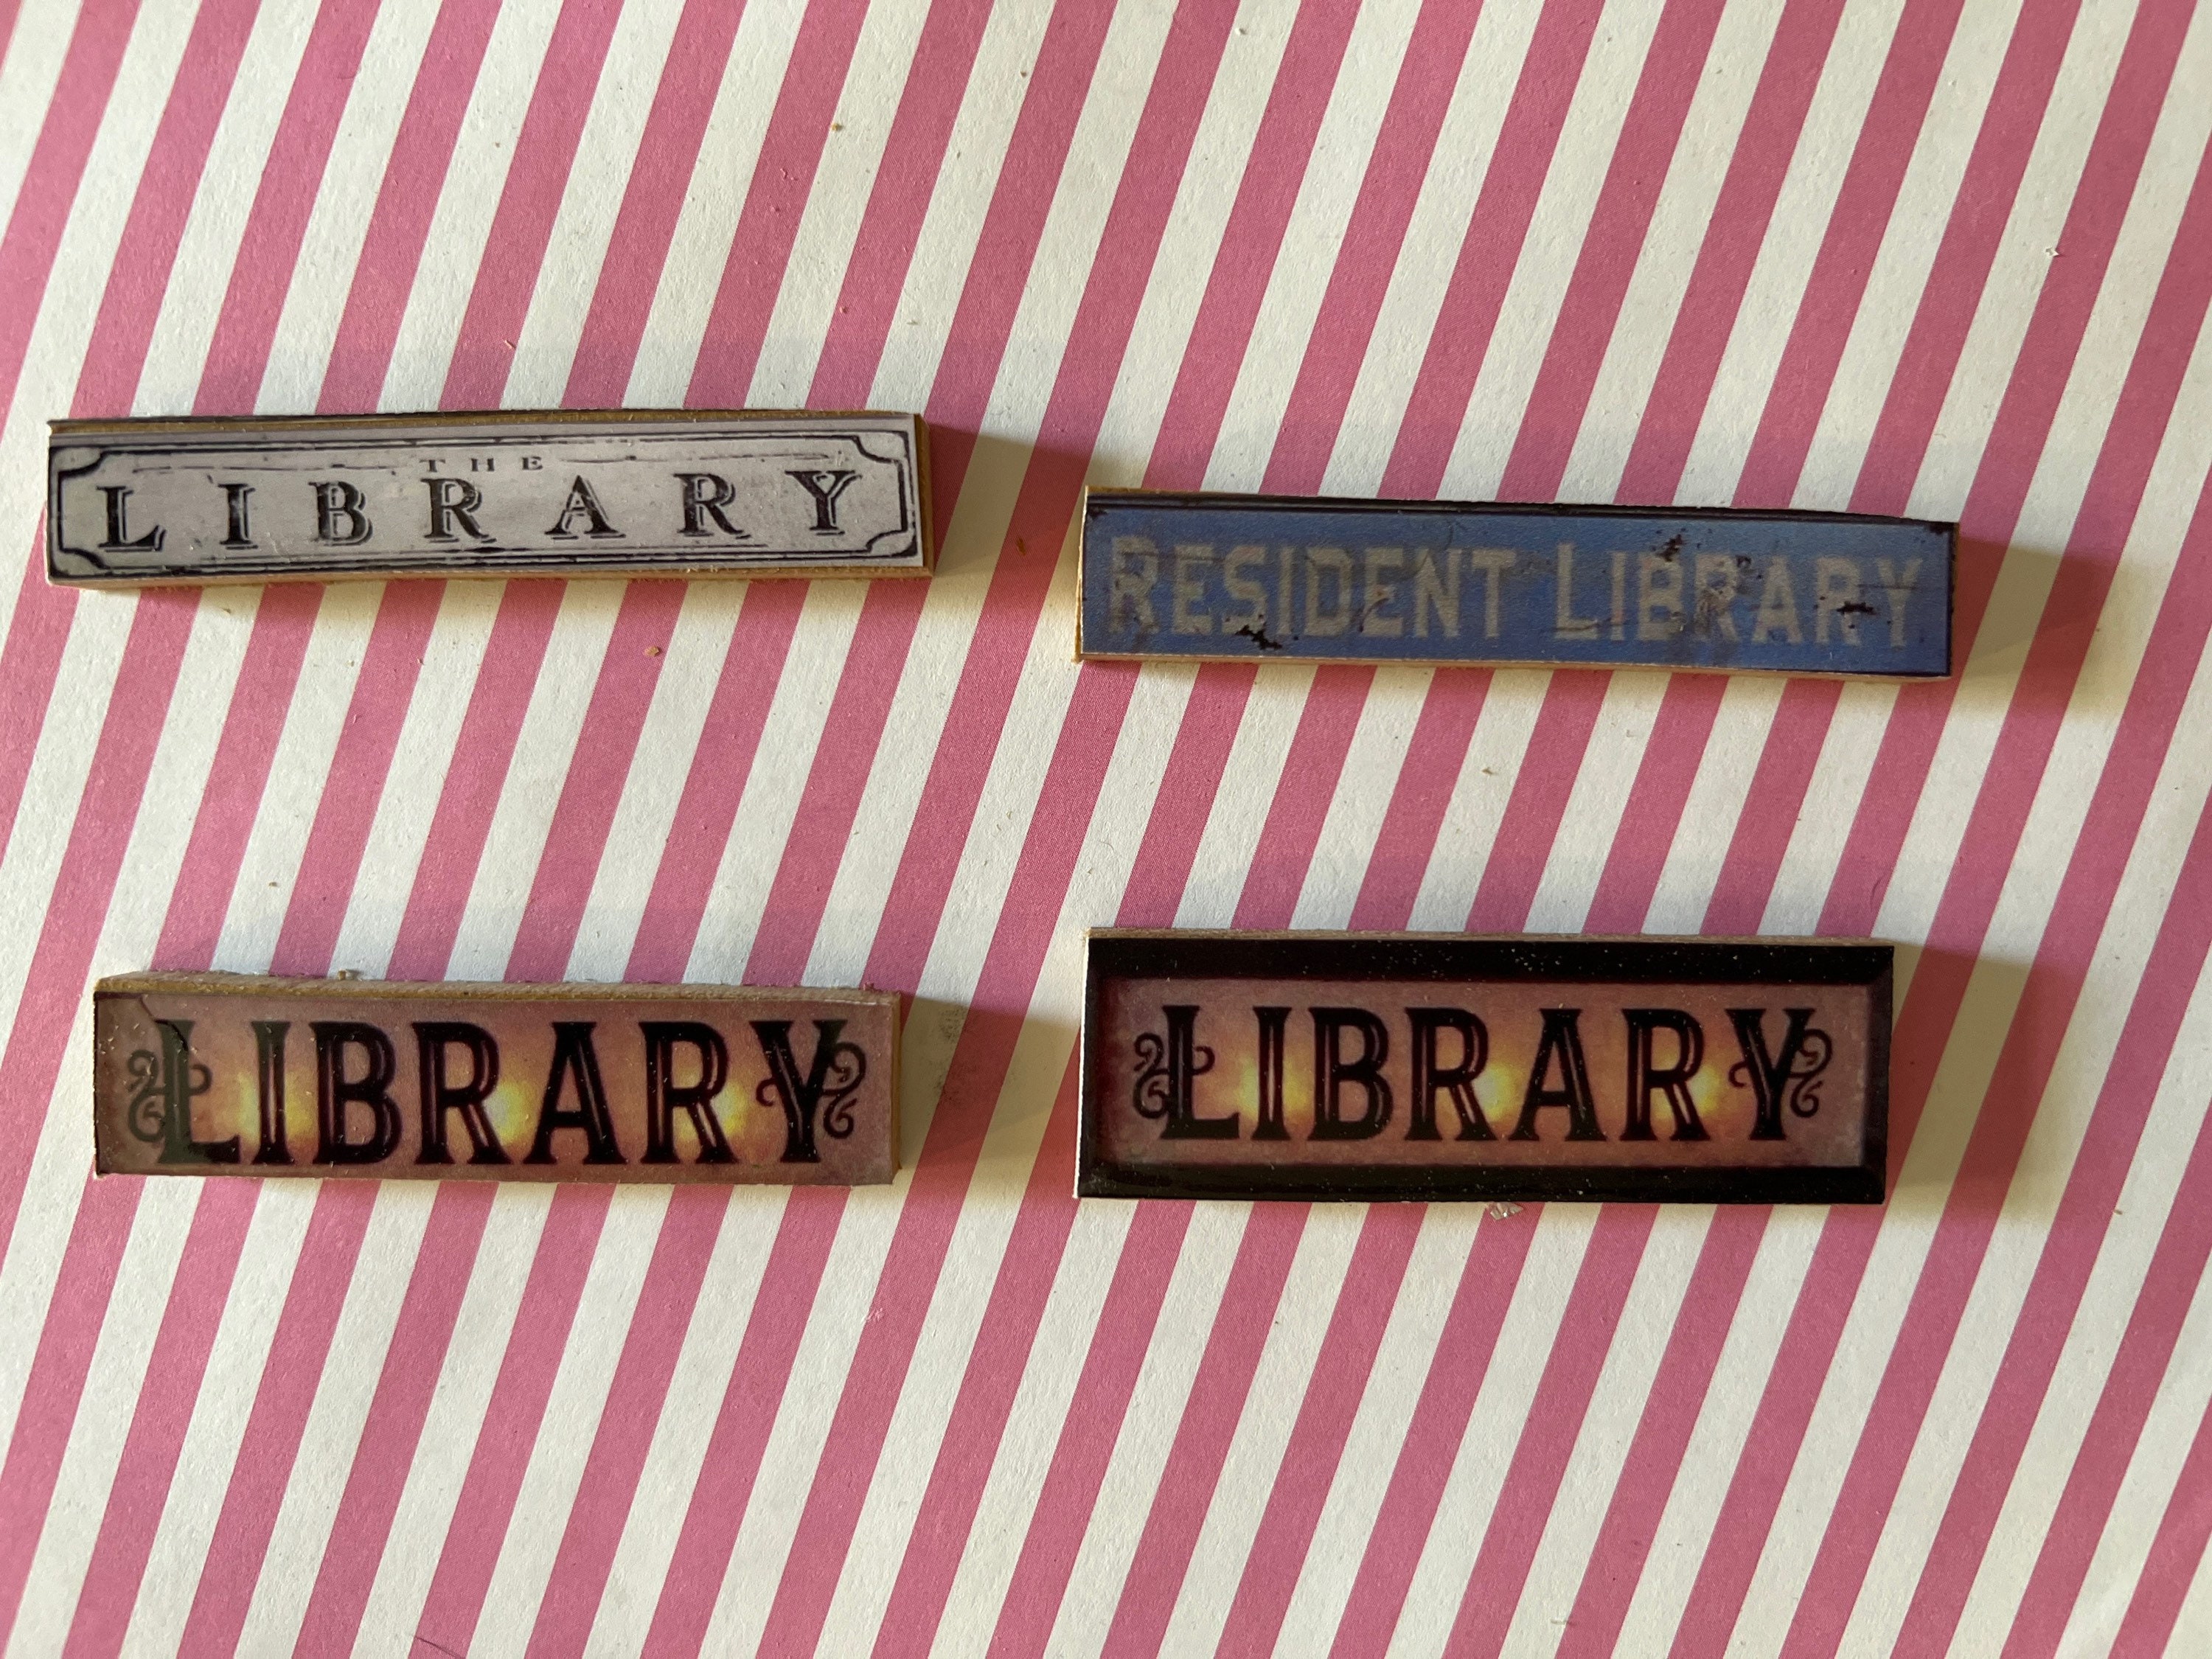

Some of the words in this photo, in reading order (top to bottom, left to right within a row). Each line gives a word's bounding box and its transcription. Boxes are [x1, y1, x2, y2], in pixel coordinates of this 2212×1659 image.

[97, 469, 863, 551] LIBRARY
[420, 456, 544, 473] THE
[1108, 535, 1517, 639] RESIDENT
[1552, 542, 1923, 647] LIBRARY
[125, 1020, 867, 1166] LIBRARY
[1134, 1004, 1834, 1142] LIBRARY
